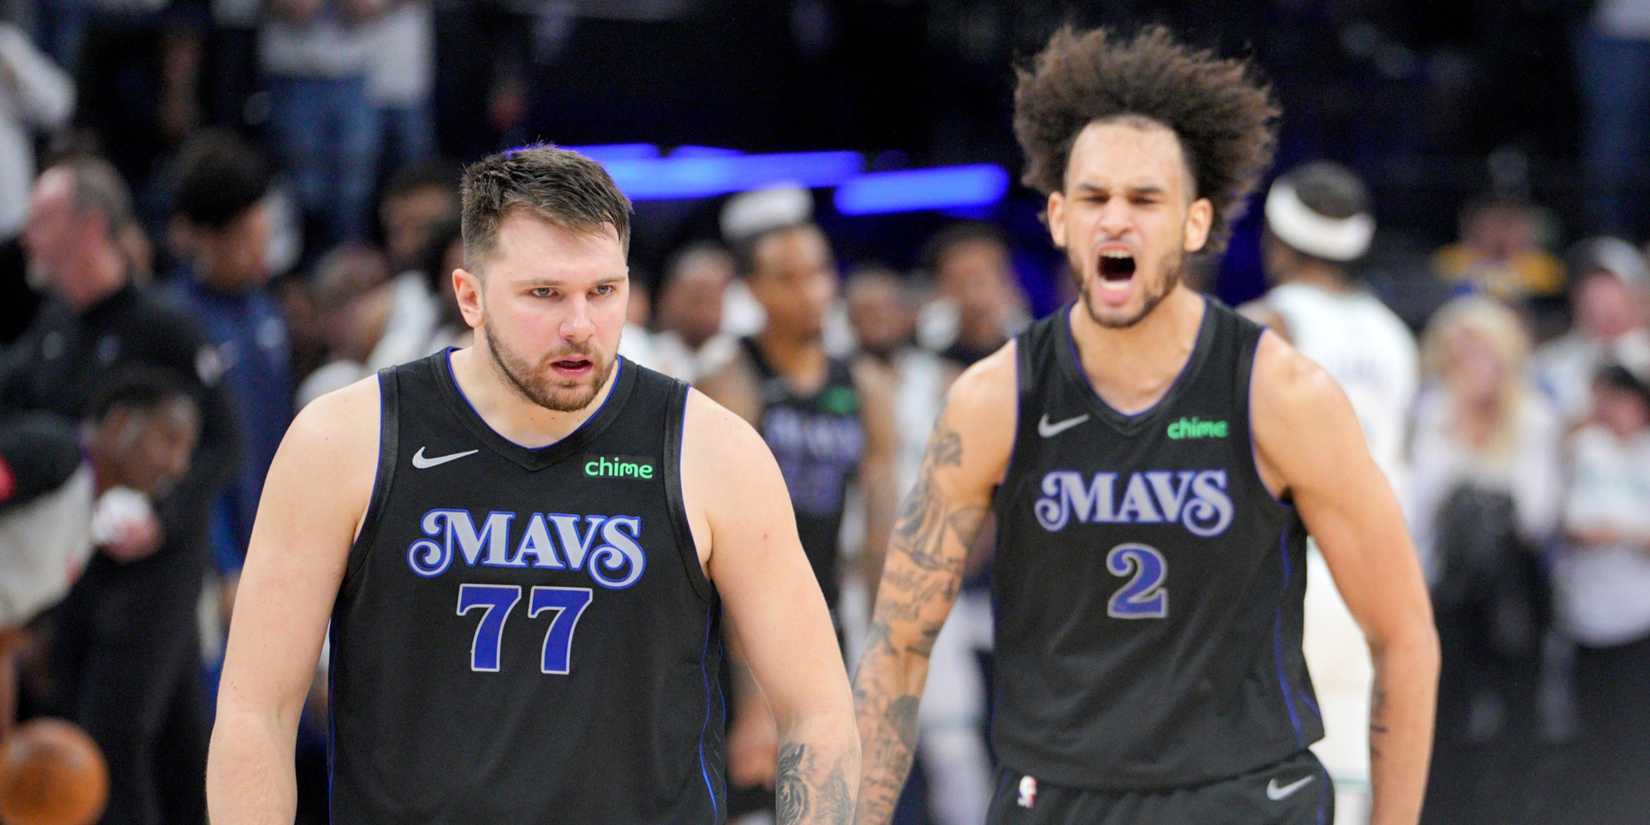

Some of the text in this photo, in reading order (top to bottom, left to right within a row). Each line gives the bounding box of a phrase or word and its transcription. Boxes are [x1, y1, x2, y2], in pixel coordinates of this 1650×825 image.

[1167, 416, 1228, 439] chime
[584, 456, 653, 479] chime
[1034, 469, 1234, 537] MAVS
[407, 508, 647, 589] MAVS
[1106, 542, 1168, 619] 2
[456, 583, 593, 675] 77
